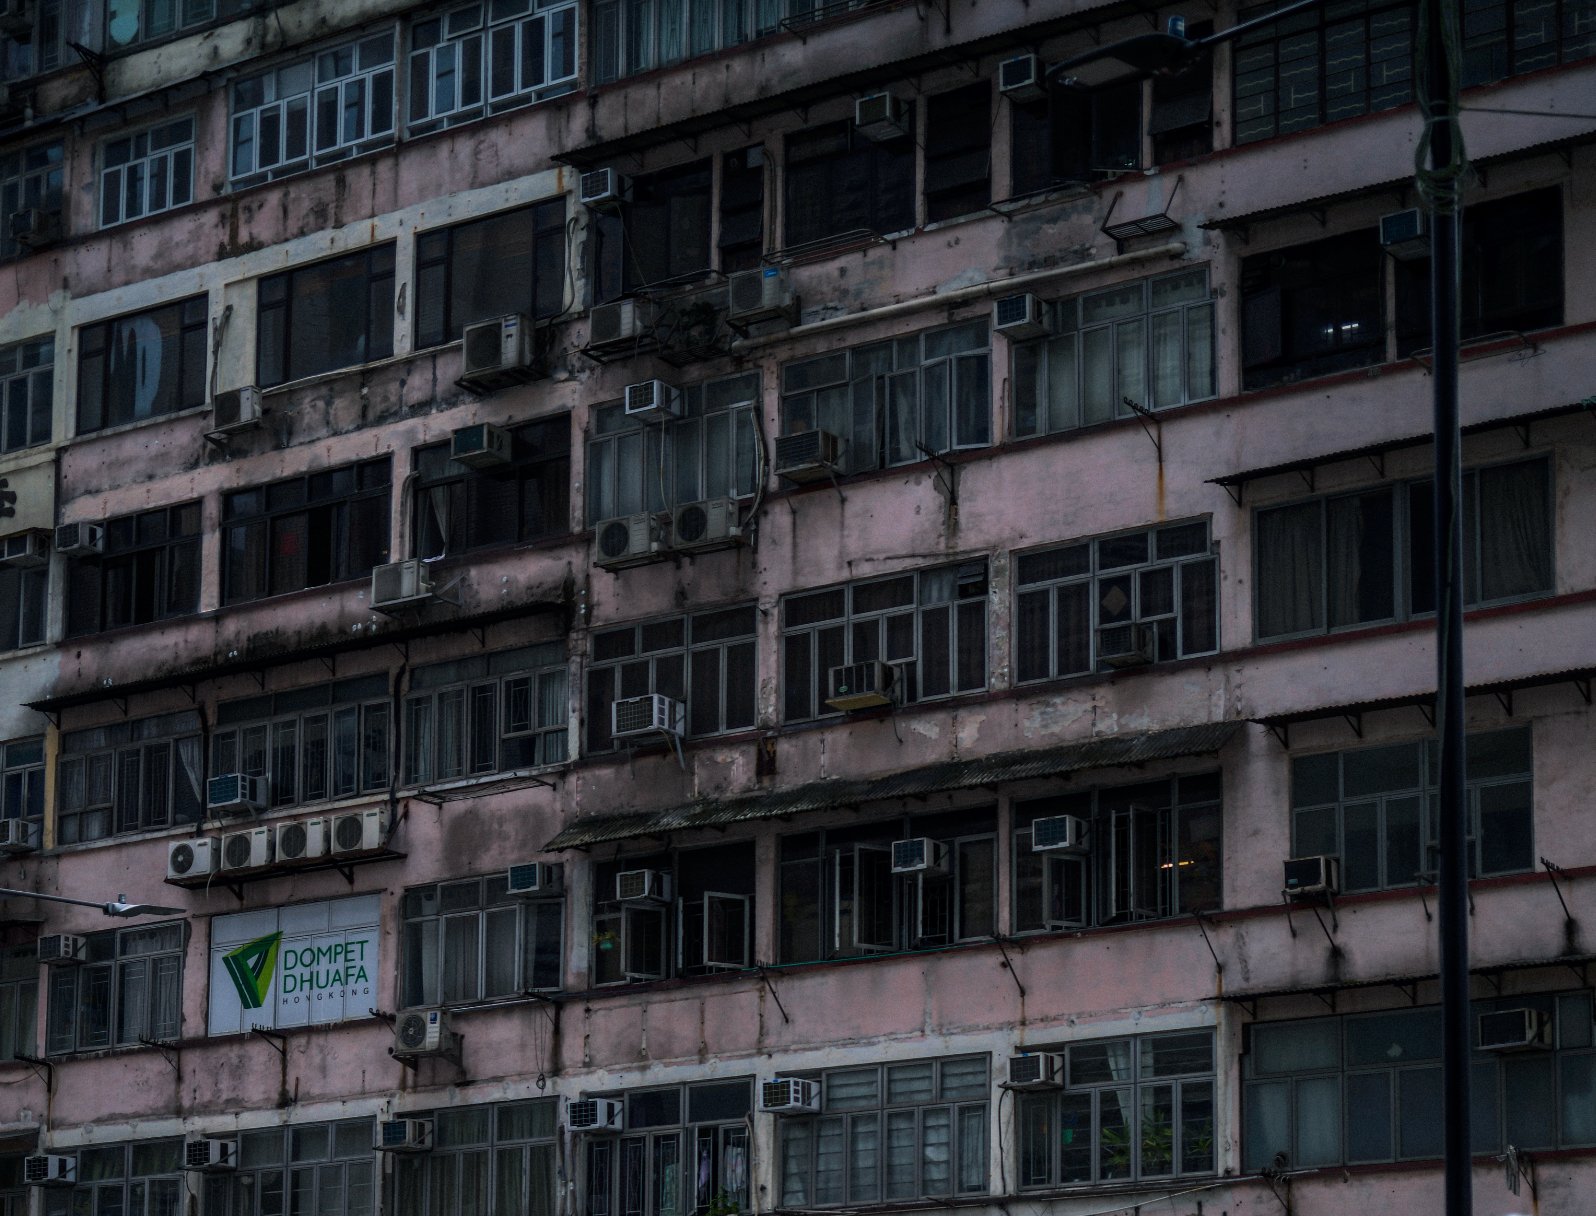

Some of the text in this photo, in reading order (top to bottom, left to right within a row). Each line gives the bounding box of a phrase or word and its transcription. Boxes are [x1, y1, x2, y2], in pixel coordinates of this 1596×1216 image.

[284, 940, 369, 970] DOMPET
[283, 965, 368, 993] DHUAFA
[282, 987, 369, 1004] HONGKONG
